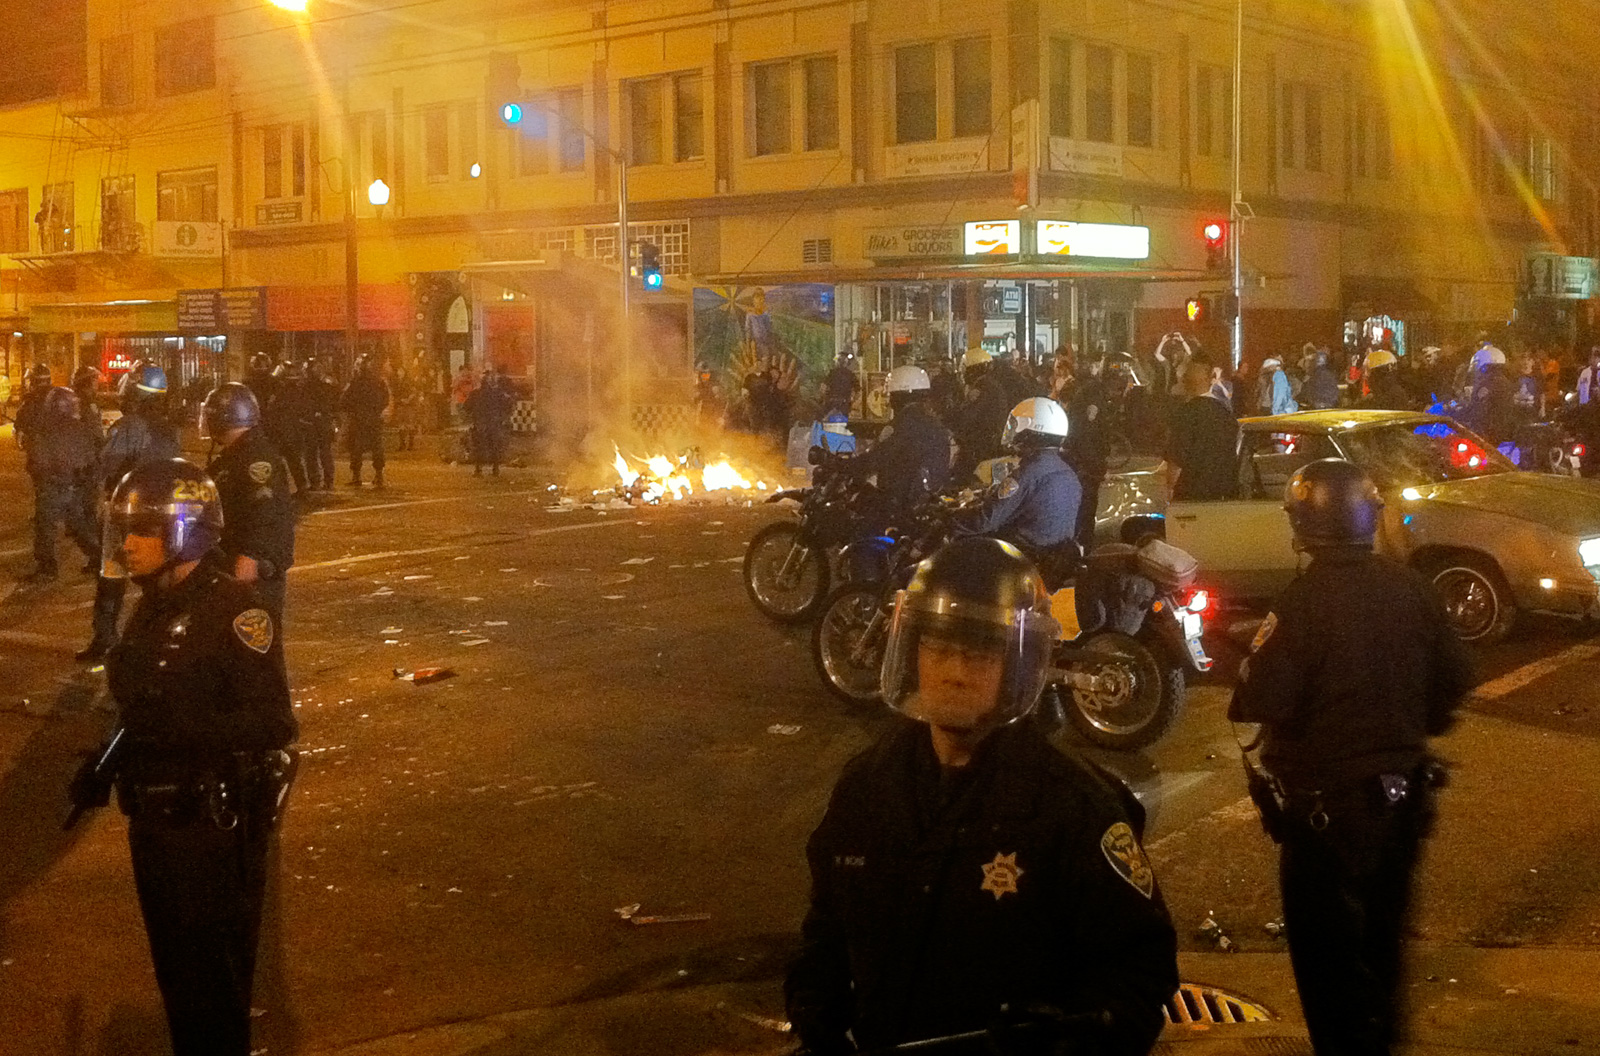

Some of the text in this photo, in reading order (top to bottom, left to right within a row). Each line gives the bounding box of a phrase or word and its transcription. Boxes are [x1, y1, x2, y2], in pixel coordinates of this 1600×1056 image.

[903, 228, 960, 241] GROCERIES
[908, 241, 954, 254] LIQUORS
[1005, 290, 1019, 299] ATM
